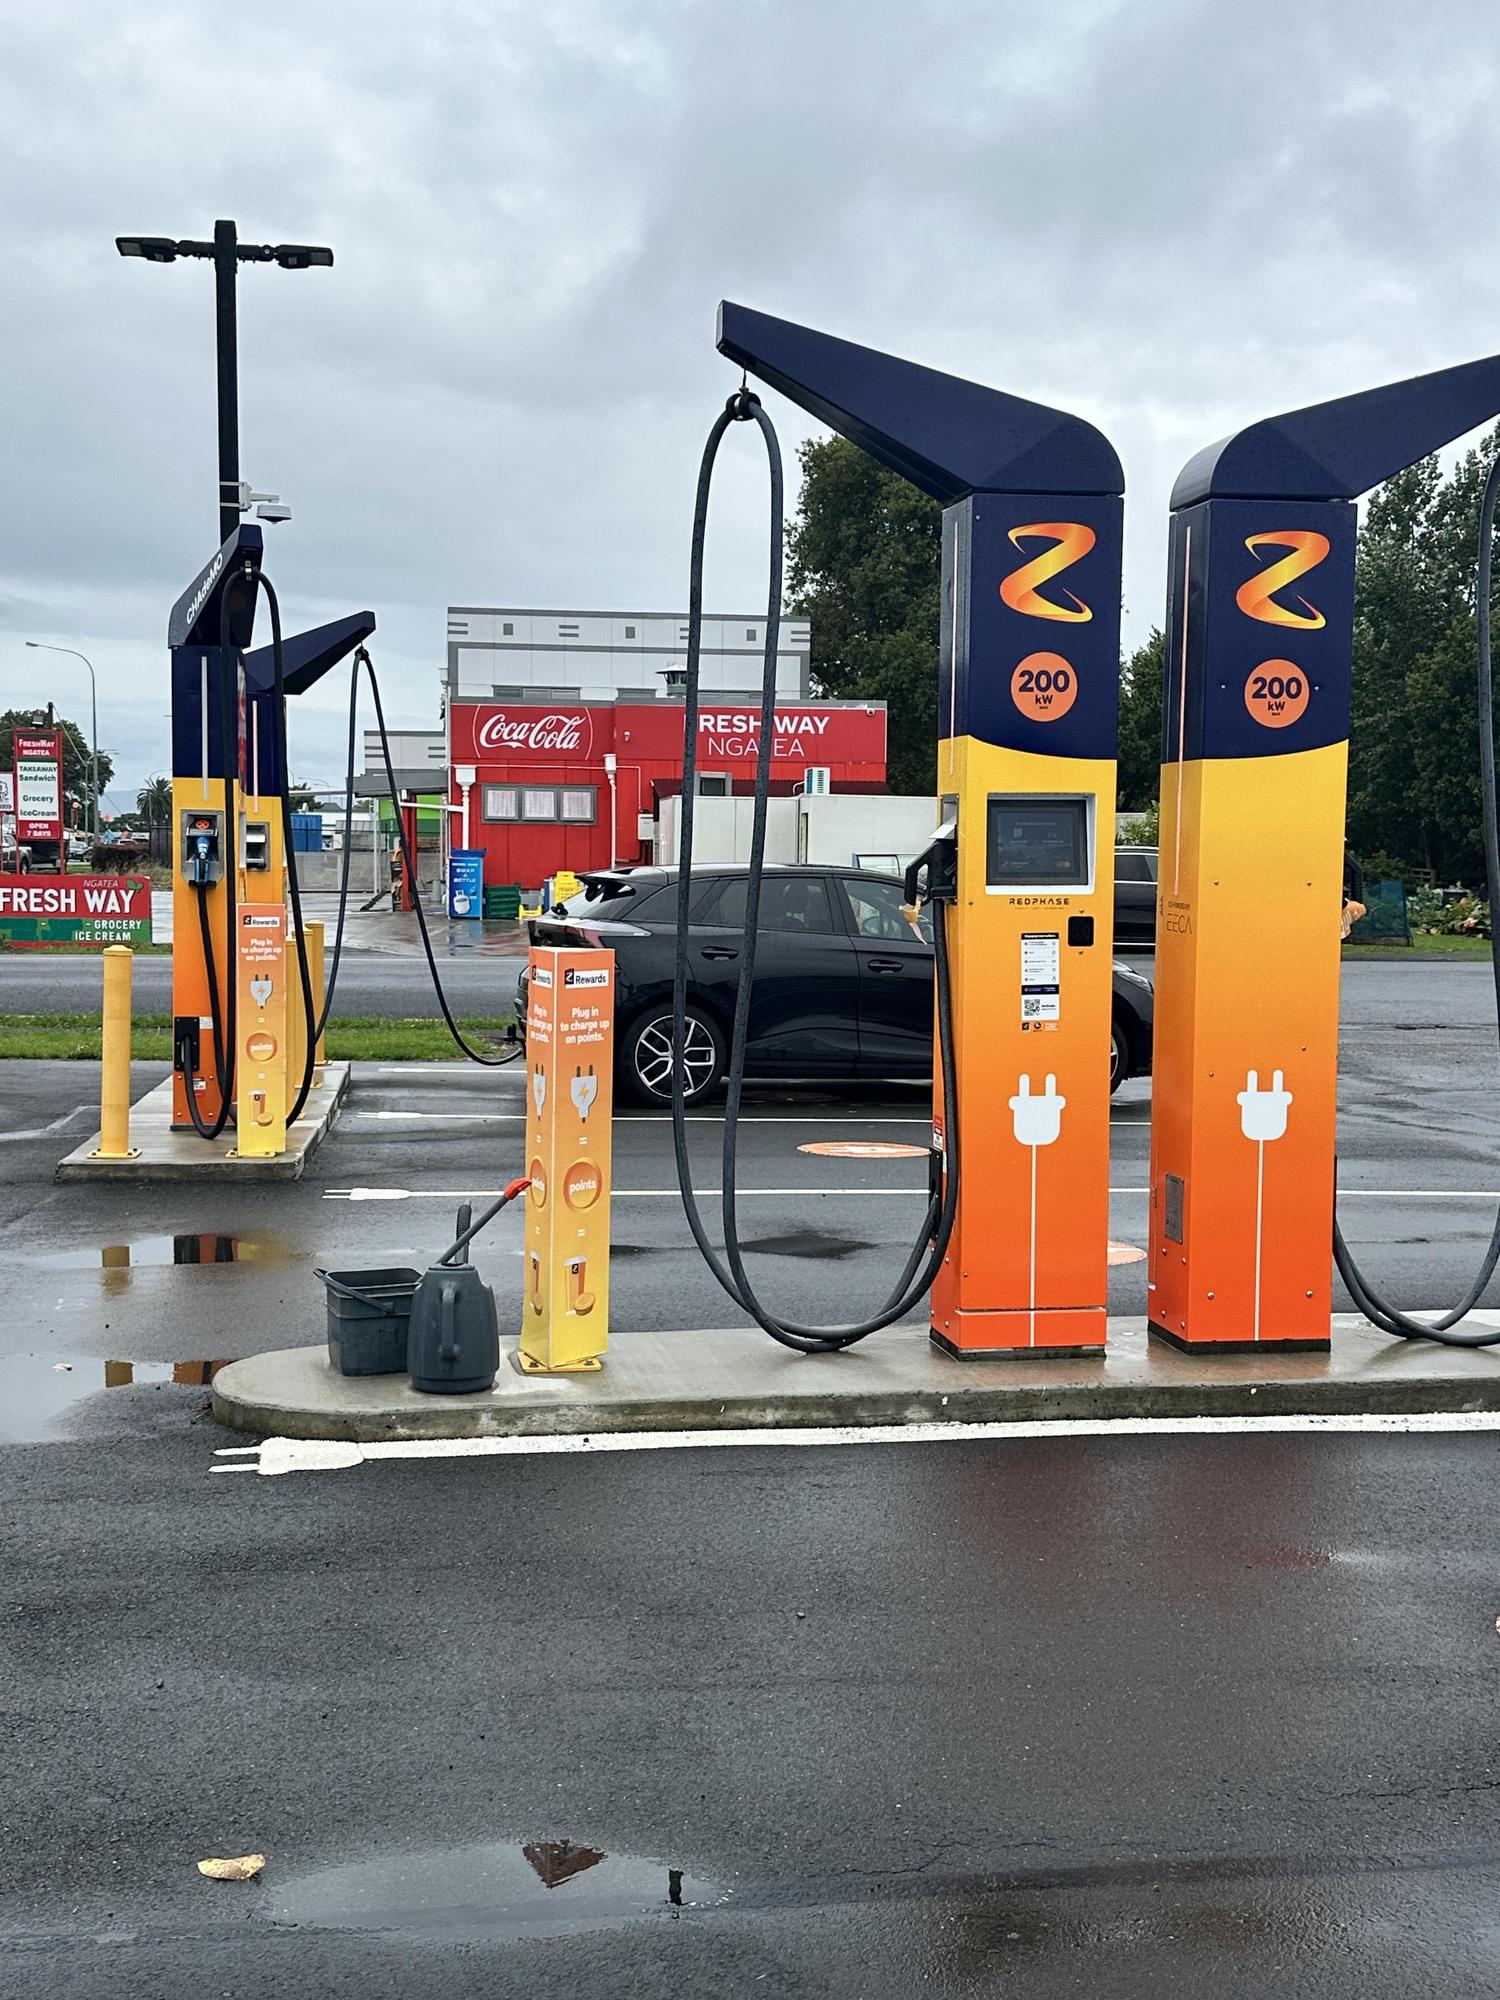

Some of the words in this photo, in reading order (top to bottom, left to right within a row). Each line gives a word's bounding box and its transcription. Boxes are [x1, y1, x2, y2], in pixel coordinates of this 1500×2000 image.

[1000, 522, 1096, 623] Z
[1236, 530, 1330, 630] Z
[186, 552, 223, 625] CHAdeMO
[1018, 669, 1070, 693] 200
[1251, 676, 1303, 700] 200
[1035, 694, 1054, 705] kW
[1267, 701, 1286, 711] kW
[479, 713, 587, 750] Coca-Cola
[684, 714, 763, 734] RESH
[773, 715, 830, 735] WAY
[708, 737, 805, 757] NGAEA
[19, 774, 56, 782] Sandwich
[22, 794, 54, 804] Grocery
[20, 809, 57, 817] IceCream
[83, 880, 119, 888] NGATEA
[0, 888, 76, 912] FRESH
[83, 889, 135, 913] WAY
[1009, 897, 1070, 906] REDPHASE
[94, 920, 142, 929] GROCERY
[75, 931, 91, 940] ICE
[95, 931, 131, 940] CREAM
[575, 972, 607, 985] Rewards
[571, 1007, 590, 1020] Plug
[591, 1006, 600, 1017] in
[560, 1022, 569, 1032] to
[570, 1020, 598, 1032] charge
[599, 1020, 610, 1031] up
[565, 1035, 576, 1044] on
[577, 1032, 605, 1046] points.
[569, 1179, 597, 1195] points
